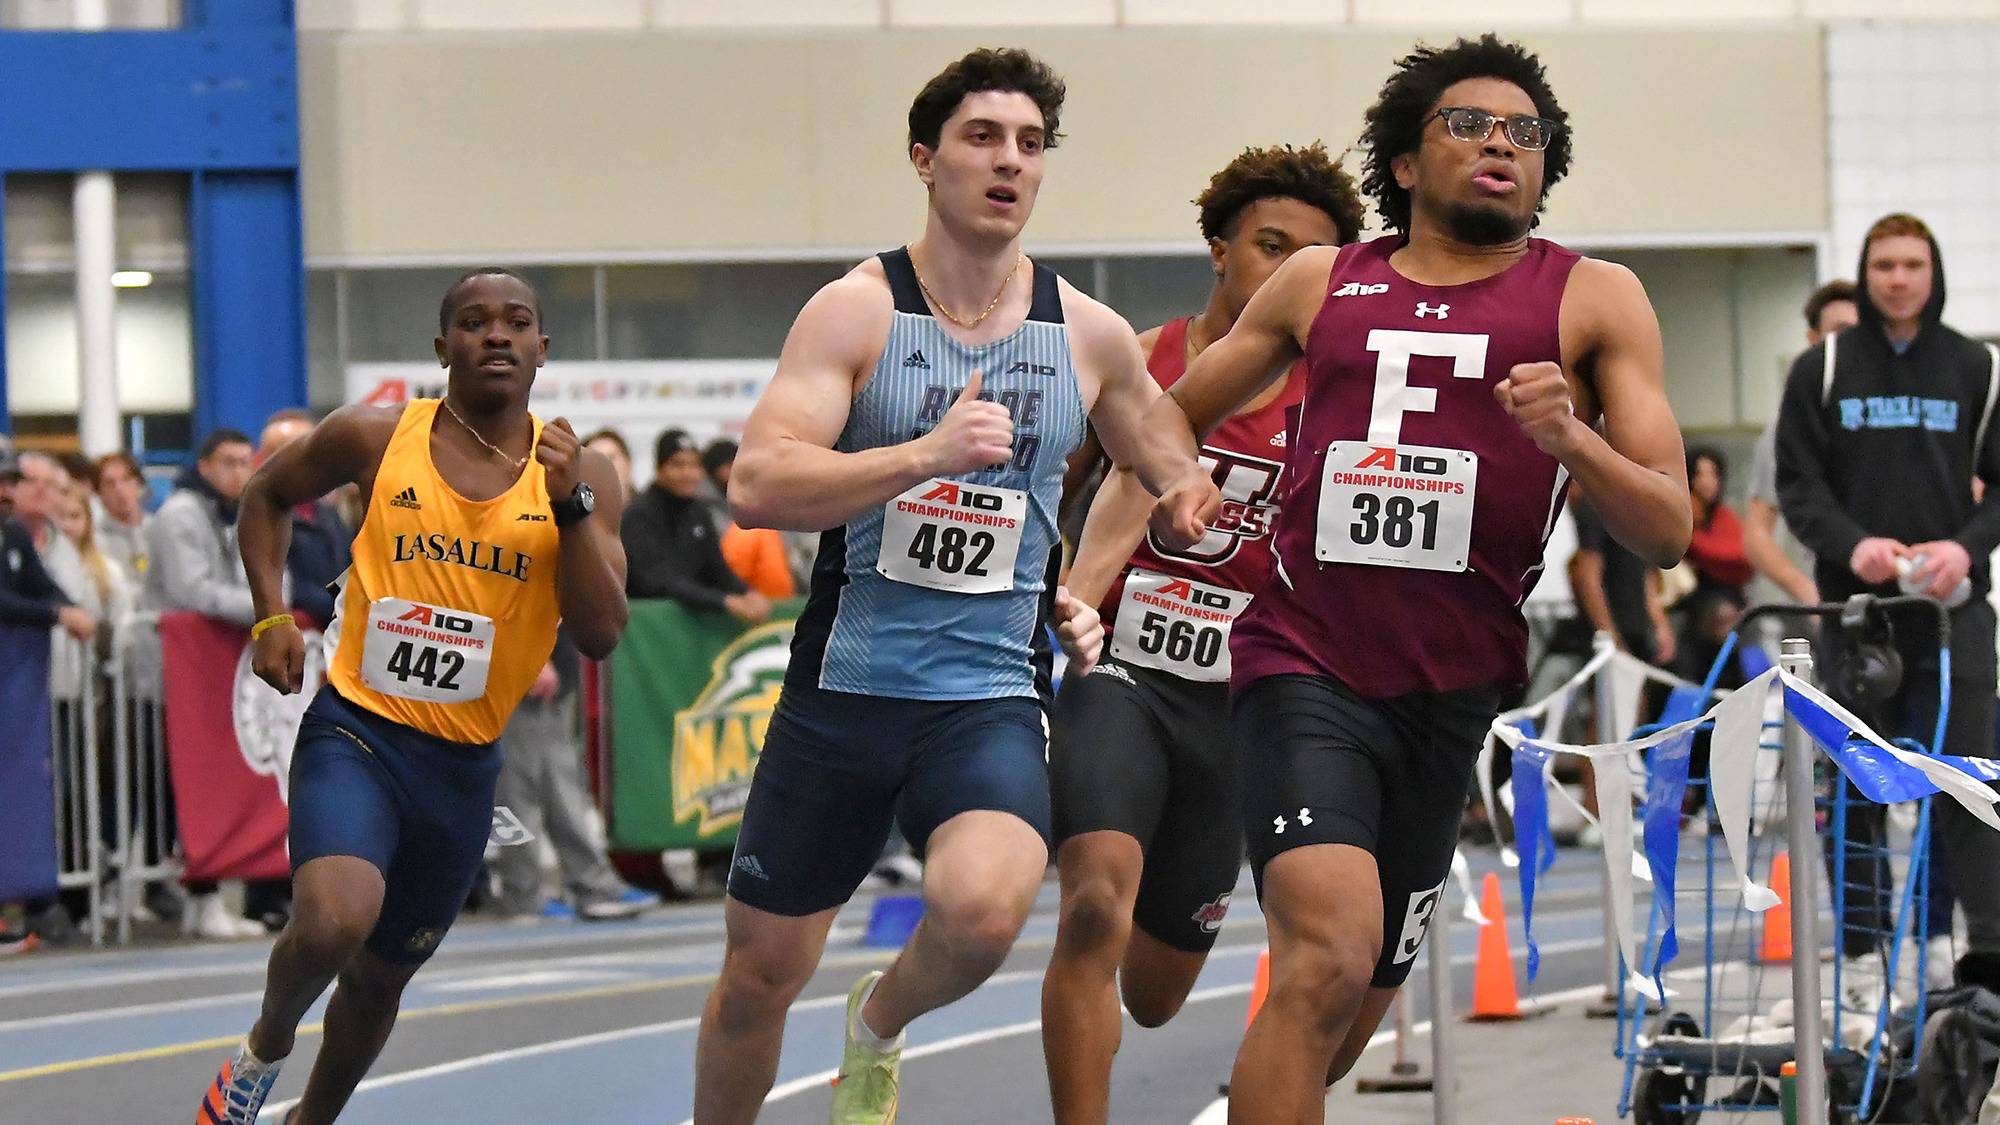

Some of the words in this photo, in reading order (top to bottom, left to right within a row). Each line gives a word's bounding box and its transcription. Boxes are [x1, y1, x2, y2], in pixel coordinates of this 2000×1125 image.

[1332, 282, 1389, 297] A10
[903, 361, 931, 370] adidas
[1006, 361, 1056, 377] A10
[1366, 329, 1489, 444] F
[916, 384, 1044, 428] RDE
[1354, 446, 1447, 475] A10
[919, 480, 1003, 511] A10
[1333, 472, 1464, 495] CHAMPIONSHIPS
[390, 499, 421, 510] adidas
[516, 513, 548, 522] A10
[897, 500, 1016, 529] CHAMPIONSHIPS
[1350, 493, 1439, 550] 381
[907, 522, 995, 577] 482
[1133, 591, 1234, 624] CHAMPIONSHIP
[1154, 576, 1231, 609] A10
[397, 604, 473, 633] A10
[377, 620, 484, 650] CHAMPIONSHIPS
[1138, 611, 1222, 668] 560
[387, 641, 465, 690] 442
[1404, 890, 1439, 955] 3
